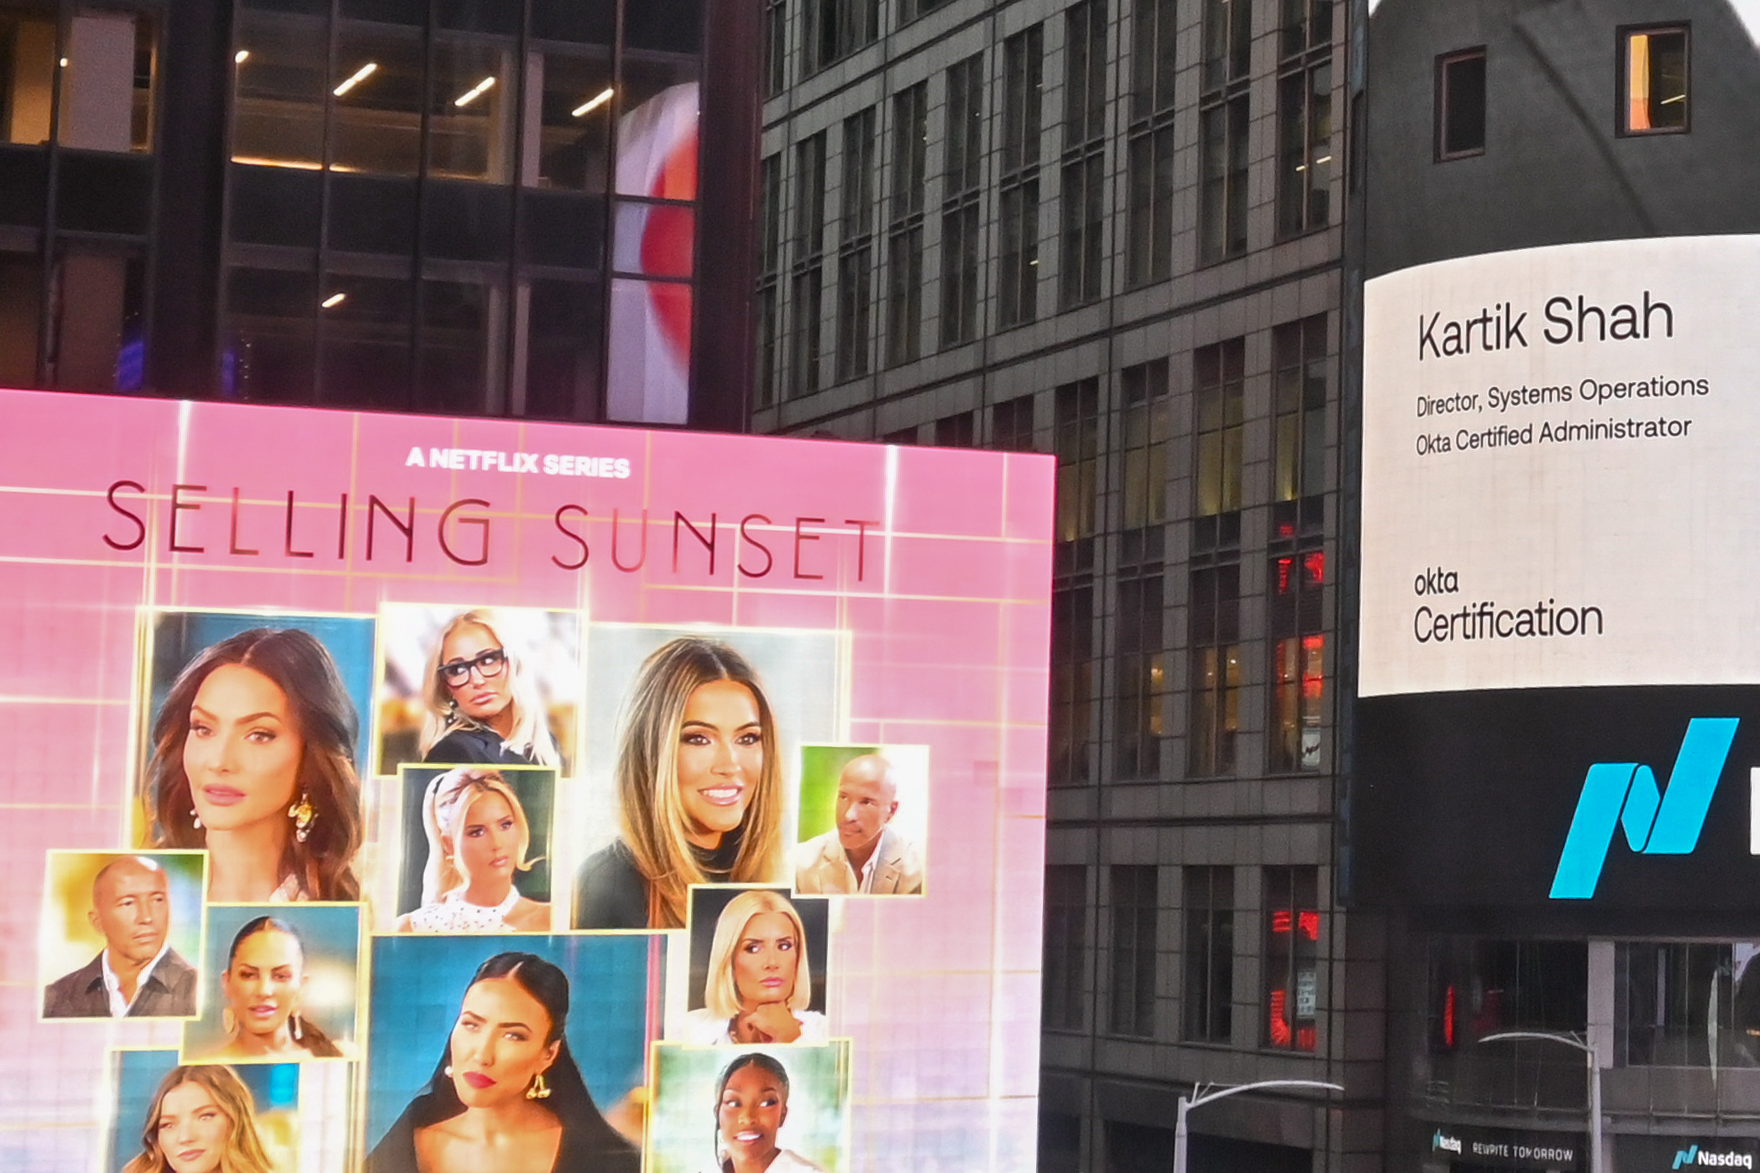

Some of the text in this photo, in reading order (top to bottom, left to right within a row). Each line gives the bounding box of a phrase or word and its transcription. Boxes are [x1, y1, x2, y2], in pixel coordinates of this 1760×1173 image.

[1418, 290, 1674, 362] Kartik Shah
[1416, 375, 1710, 418] Director, Systems Operations
[1415, 416, 1693, 456] Okta Certified Administrator
[404, 446, 632, 479] A NETFLIX SERIES
[101, 479, 881, 582] SELLING SUNSET
[1413, 566, 1460, 596] okta
[1413, 598, 1605, 644] Certification
[1439, 1135, 1574, 1162] Nasdaq REWRITE TOMORROW
[1697, 1150, 1754, 1169] Nasdaq
